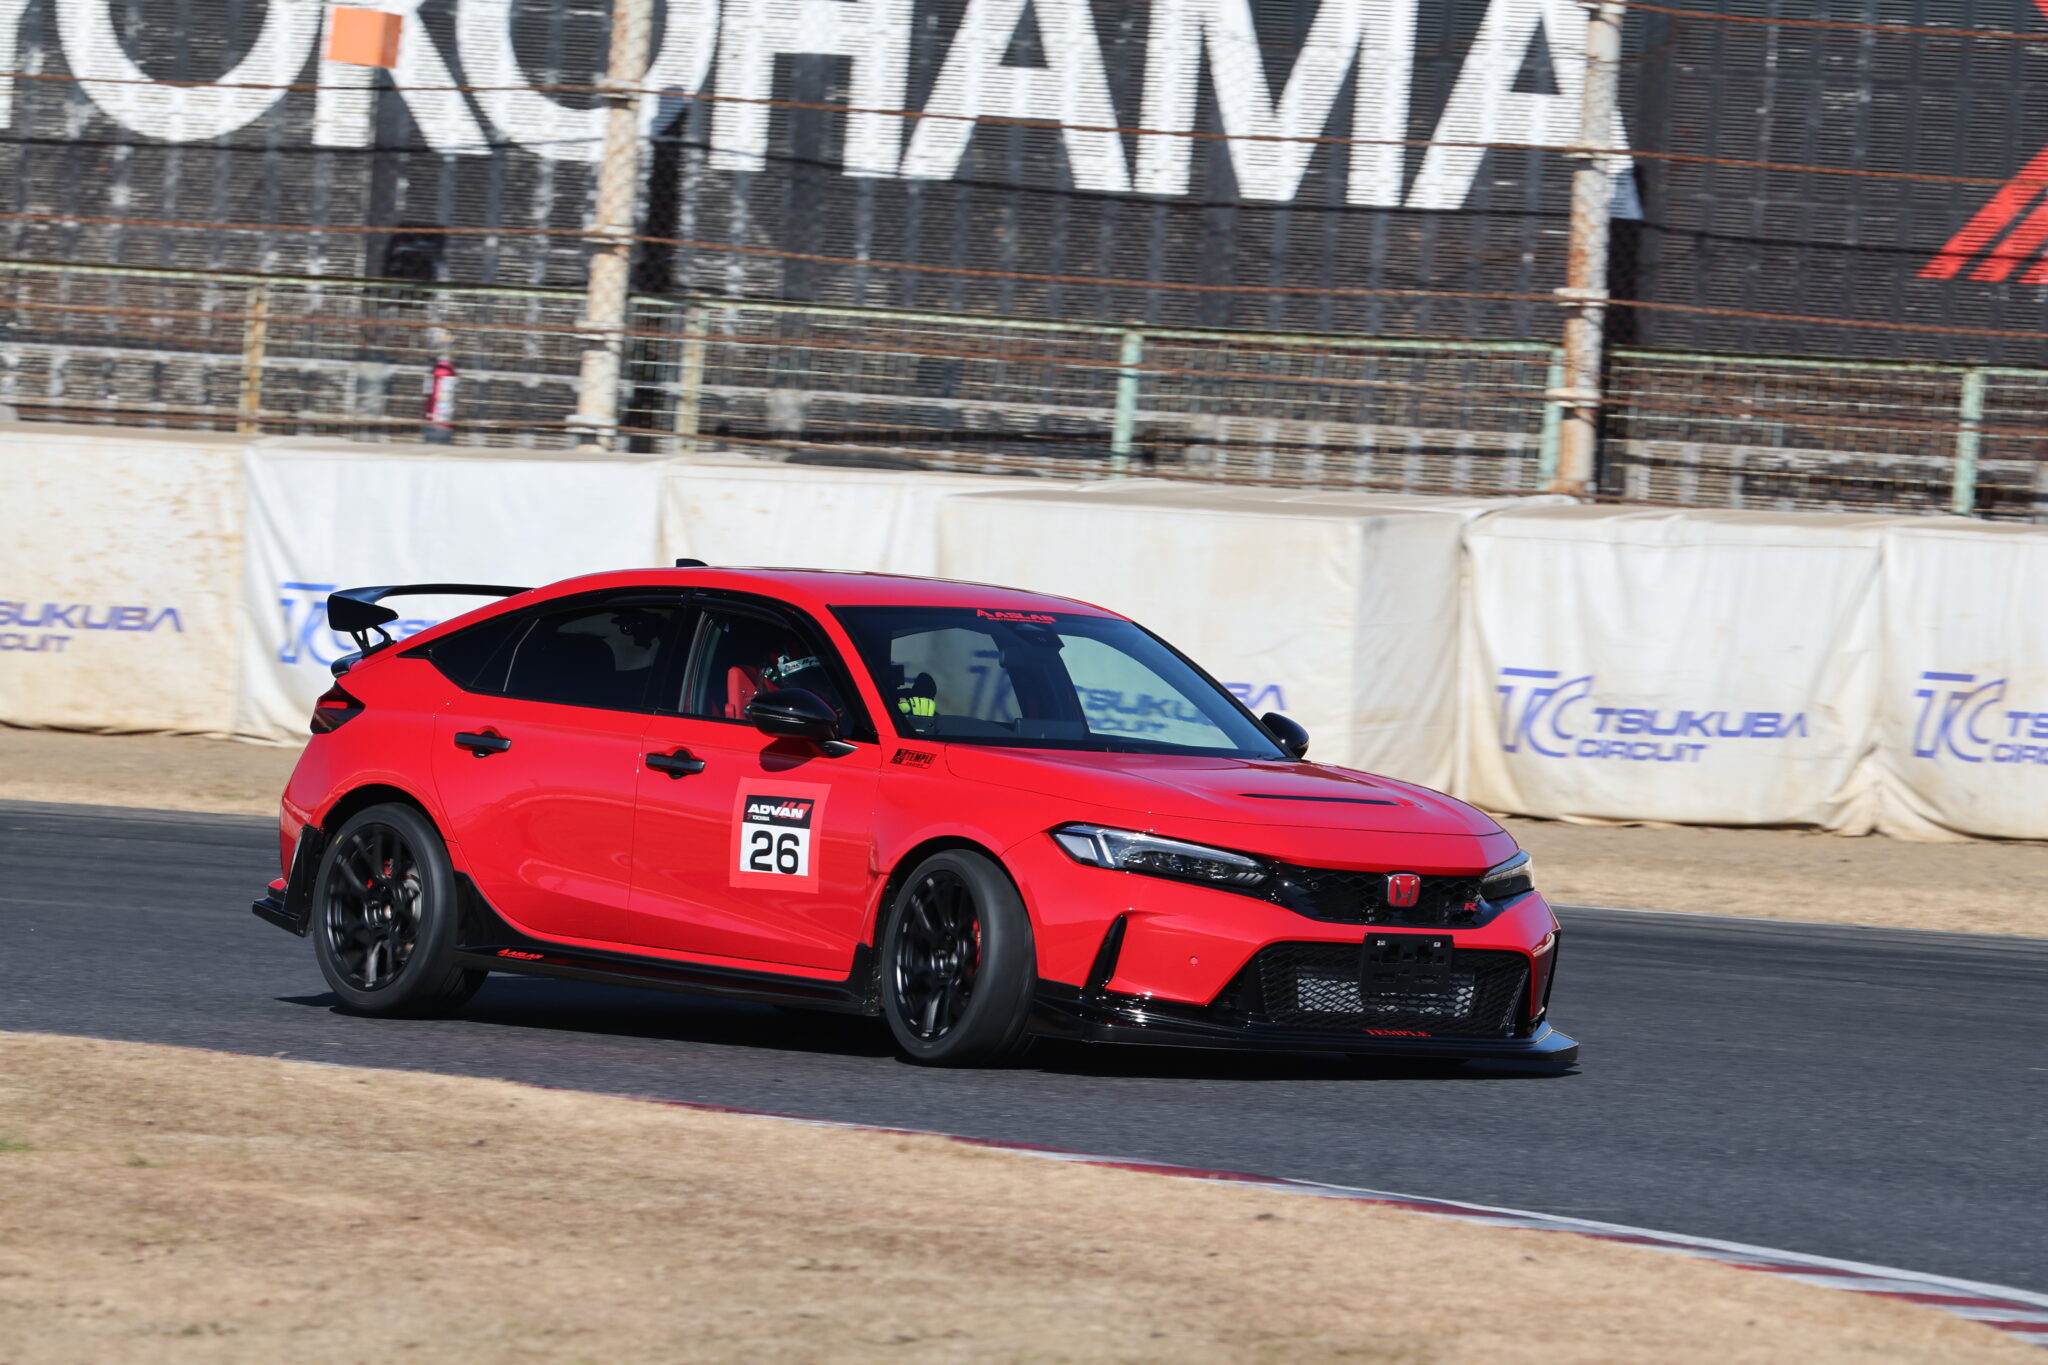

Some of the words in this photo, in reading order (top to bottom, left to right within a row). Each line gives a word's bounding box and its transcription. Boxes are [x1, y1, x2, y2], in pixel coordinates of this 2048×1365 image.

[0, 0, 1644, 219] OKOHAMA
[1592, 707, 1809, 738] TSUKUBA
[1575, 739, 1706, 762] CIRCUIT
[1991, 743, 2048, 765] CIR
[747, 803, 804, 819] ADVAN
[749, 829, 800, 875] 26
[1361, 1028, 1432, 1038] TEMPLE
